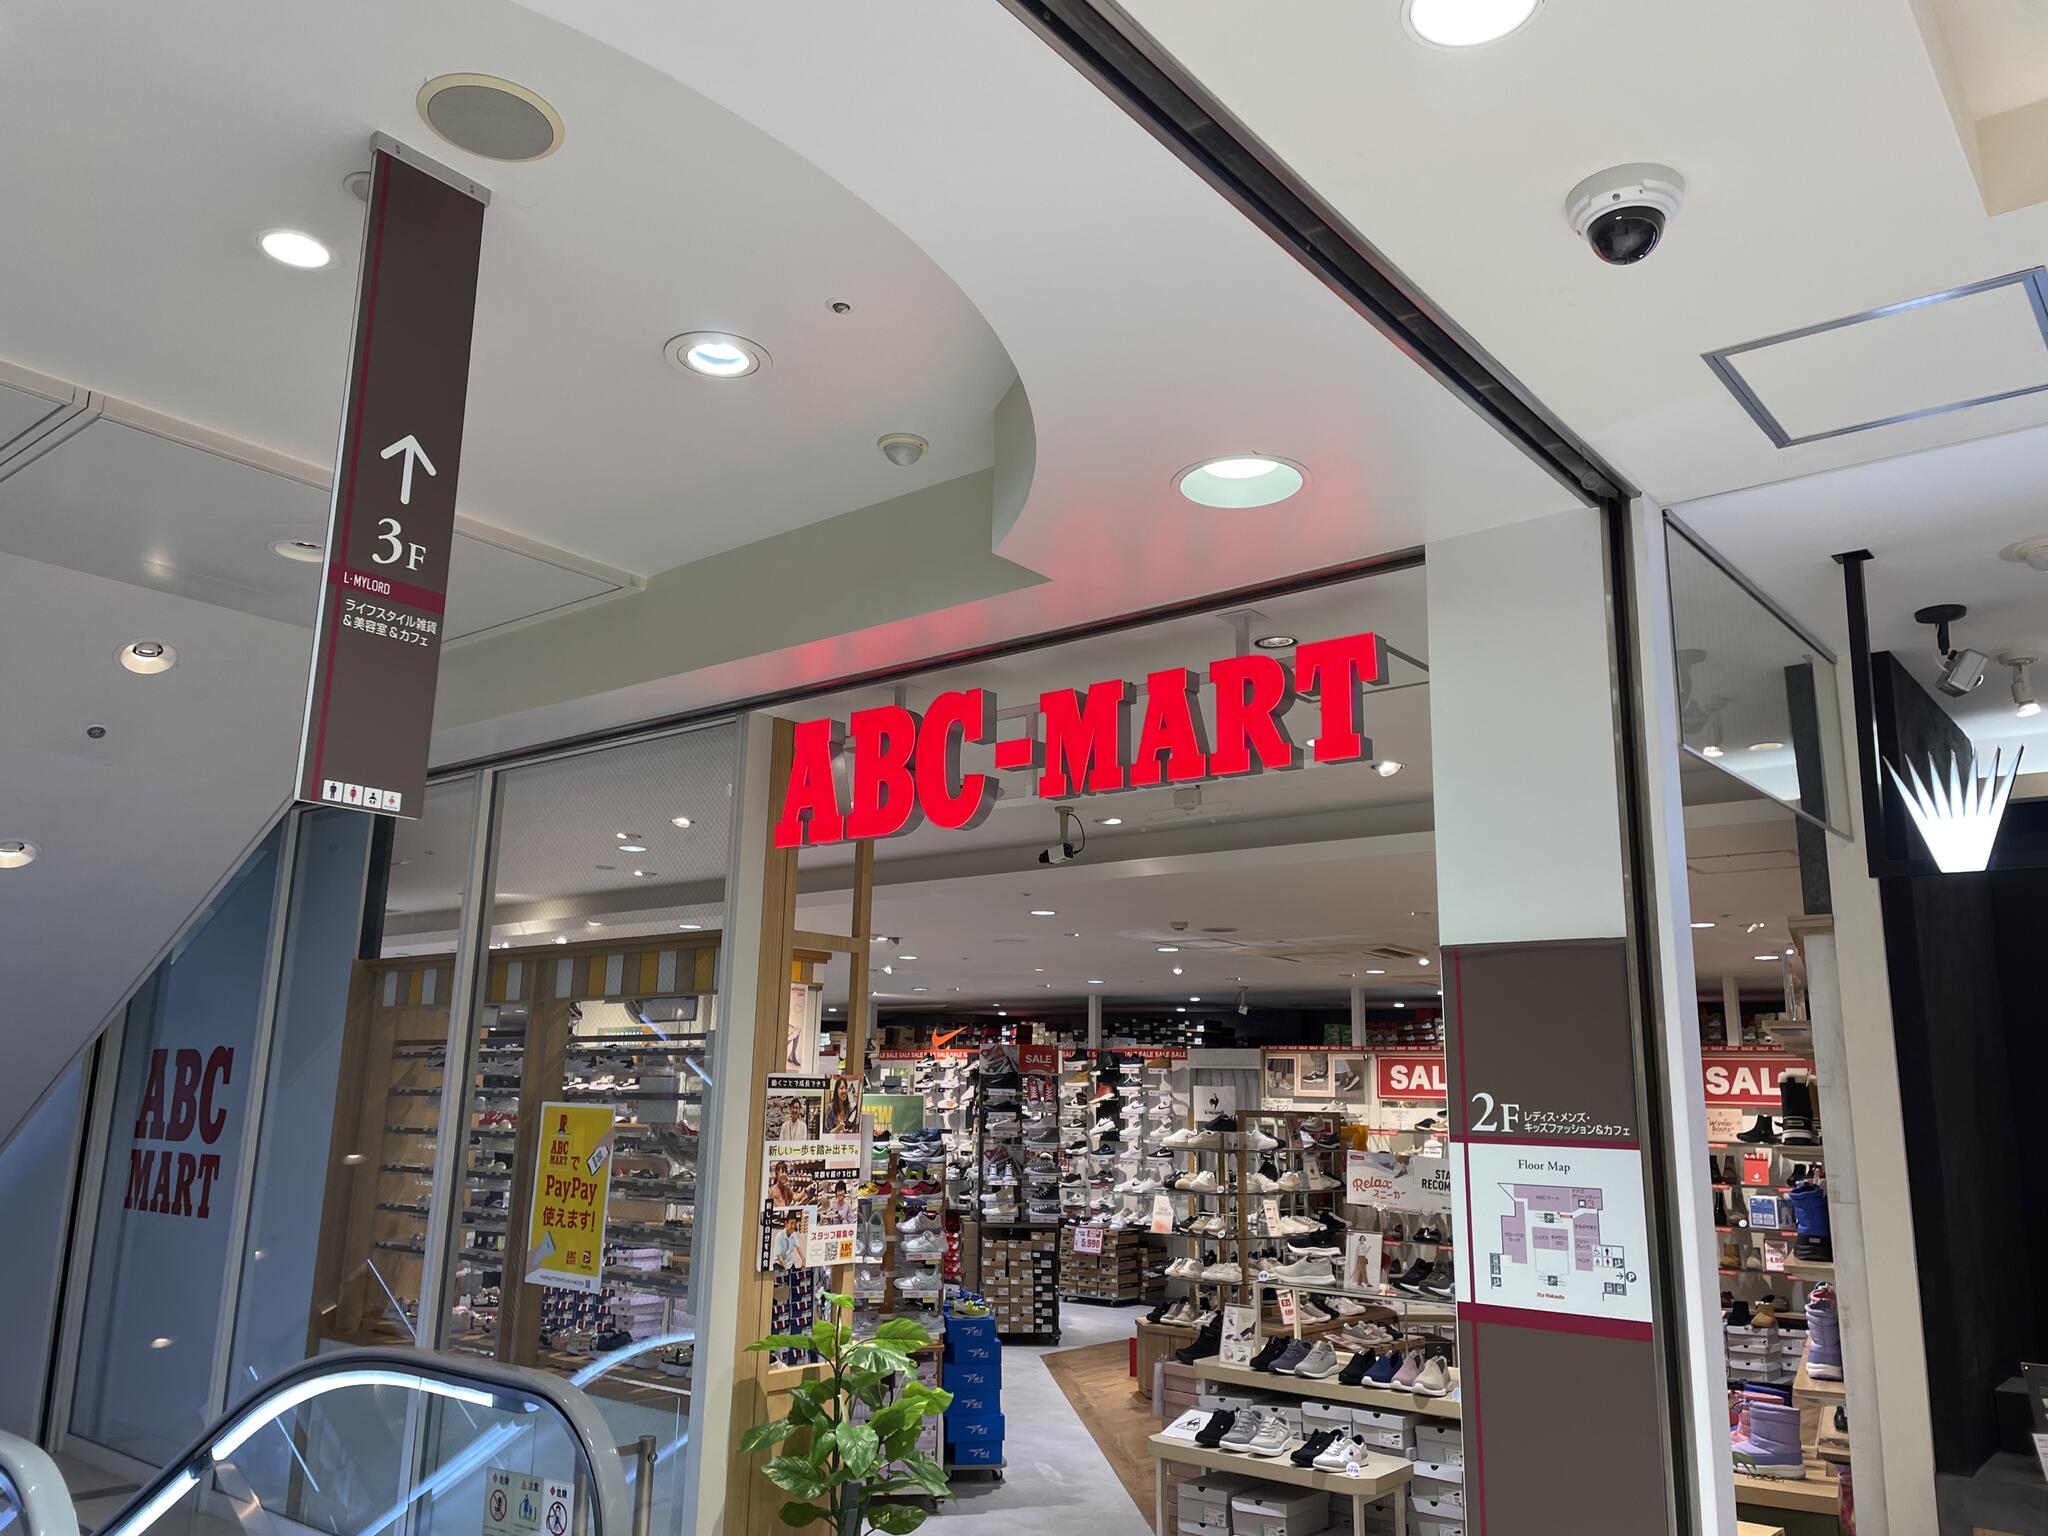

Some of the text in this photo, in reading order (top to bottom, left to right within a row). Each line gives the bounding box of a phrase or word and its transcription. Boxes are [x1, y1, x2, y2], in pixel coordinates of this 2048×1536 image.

[372, 518, 427, 571] 3F
[345, 598, 438, 635] ライフスタイル雑貨
[775, 632, 1384, 849] ABC-MART
[1025, 1054, 1052, 1064] SALE
[1705, 1066, 1808, 1095] SAL
[134, 1045, 235, 1144] ABC
[1471, 1092, 1520, 1133] 2F
[1523, 1122, 1631, 1136] キッズファッション&カフェ
[551, 1140, 569, 1155] ABC
[768, 1144, 859, 1157] 新しい一歩を踏み出そう。
[549, 1155, 568, 1166] MART
[571, 1156, 580, 1171] で
[1518, 1159, 1571, 1174] Floor Map
[124, 1149, 221, 1219] MART
[545, 1174, 598, 1207] PayPay
[1352, 1176, 1392, 1192] Relax
[1373, 1189, 1407, 1200] スニーカー
[811, 1230, 855, 1241] スタッフ募集中
[841, 1242, 853, 1252] ABC
